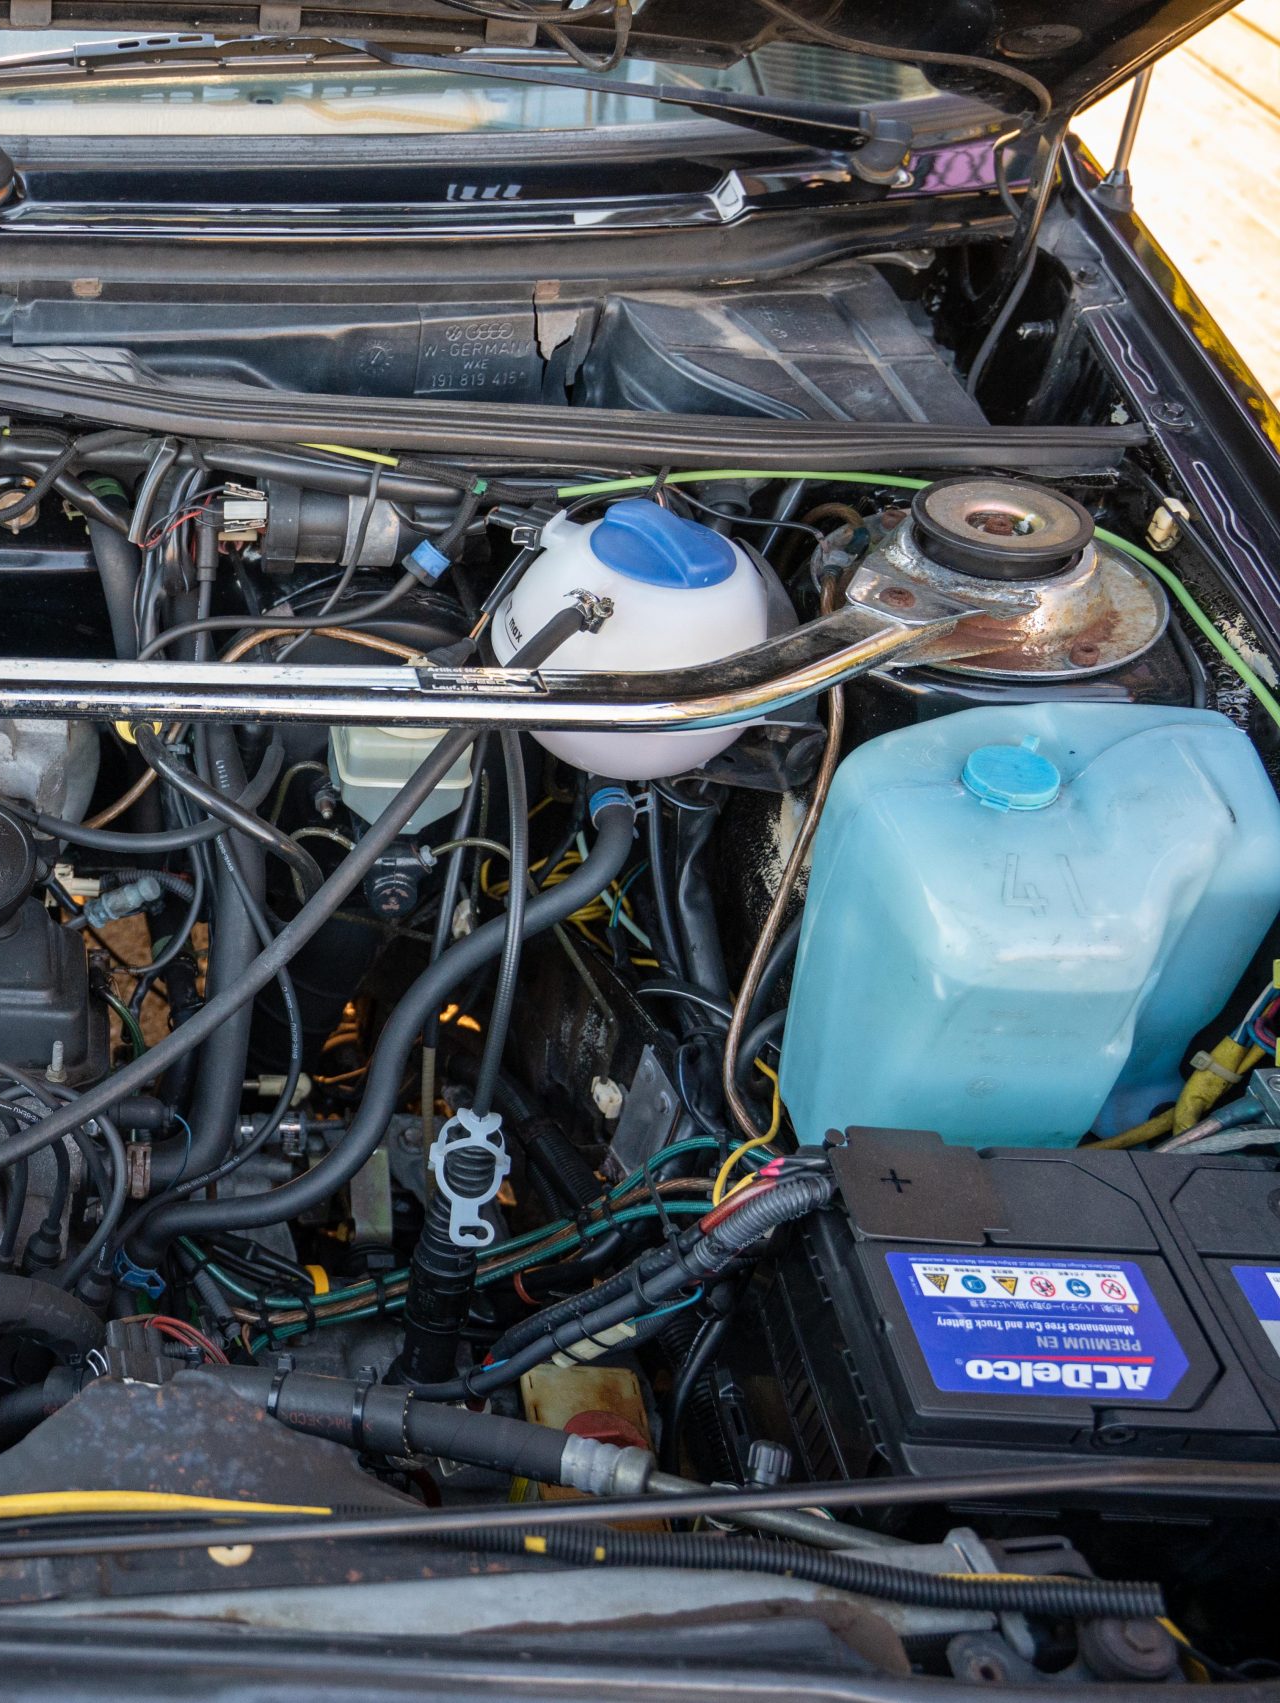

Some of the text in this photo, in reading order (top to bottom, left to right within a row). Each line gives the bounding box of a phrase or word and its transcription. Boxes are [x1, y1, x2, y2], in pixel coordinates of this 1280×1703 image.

[508, 619, 524, 641] max
[936, 1315, 1134, 1336] Maintenance Free Car and Truck Battery
[1036, 1335, 1142, 1352] PREMIUM EN
[965, 1358, 1153, 1391] ACDelco
